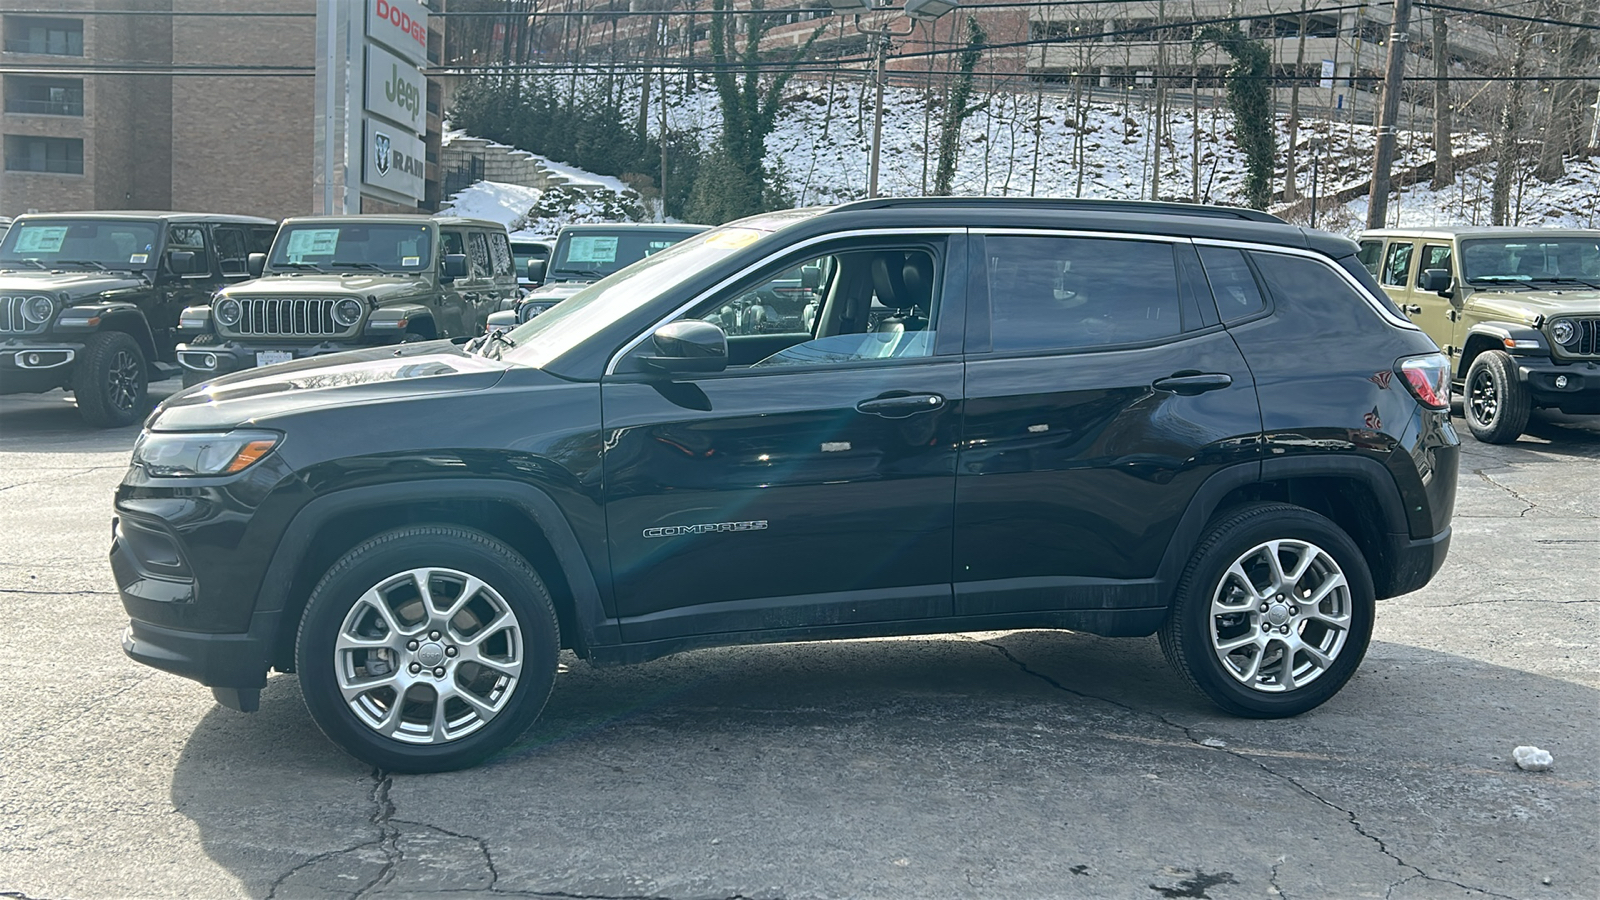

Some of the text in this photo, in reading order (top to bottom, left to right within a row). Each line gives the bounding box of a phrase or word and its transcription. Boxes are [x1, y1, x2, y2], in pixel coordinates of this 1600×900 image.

[376, 0, 426, 48] DODGE
[385, 63, 420, 121] Jeep
[393, 150, 424, 179] RAM
[643, 520, 768, 538] COMPASS
